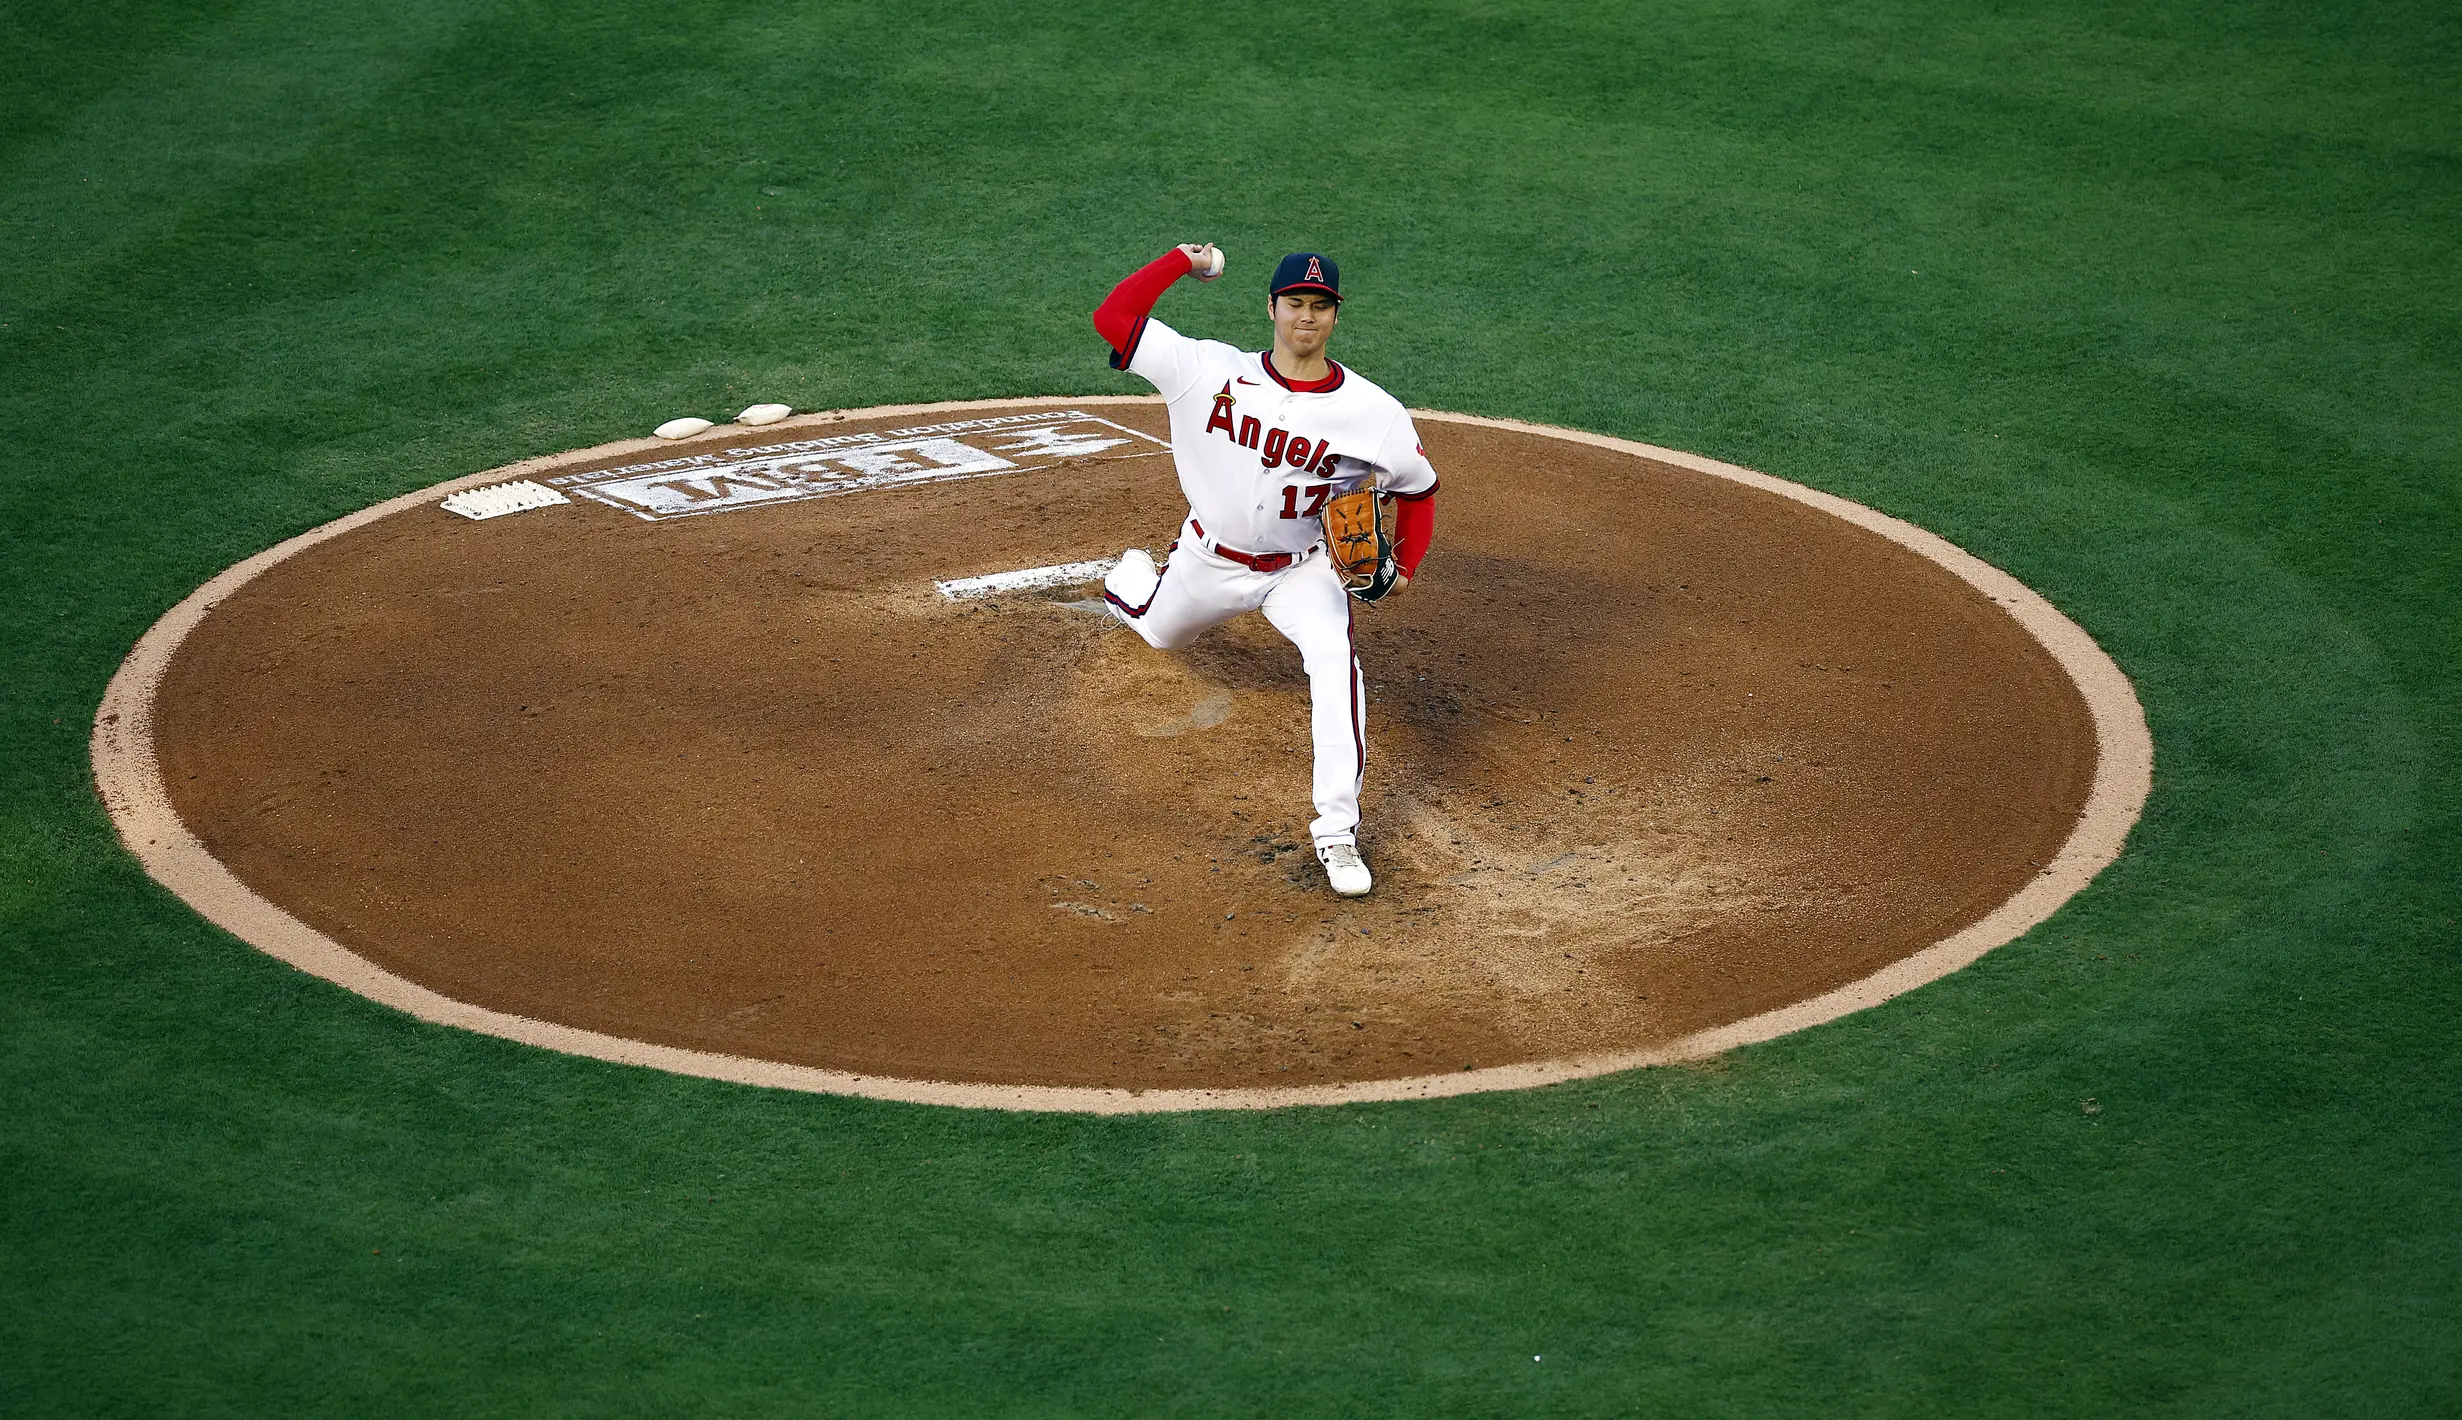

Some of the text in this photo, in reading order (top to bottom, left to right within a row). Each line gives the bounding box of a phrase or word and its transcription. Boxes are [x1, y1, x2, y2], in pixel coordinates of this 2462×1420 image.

[1304, 256, 1324, 283] A
[547, 410, 1100, 485] Foundation Building Materials
[1205, 378, 1342, 479] Angels
[647, 448, 962, 503] FBM
[1279, 483, 1332, 519] 17
